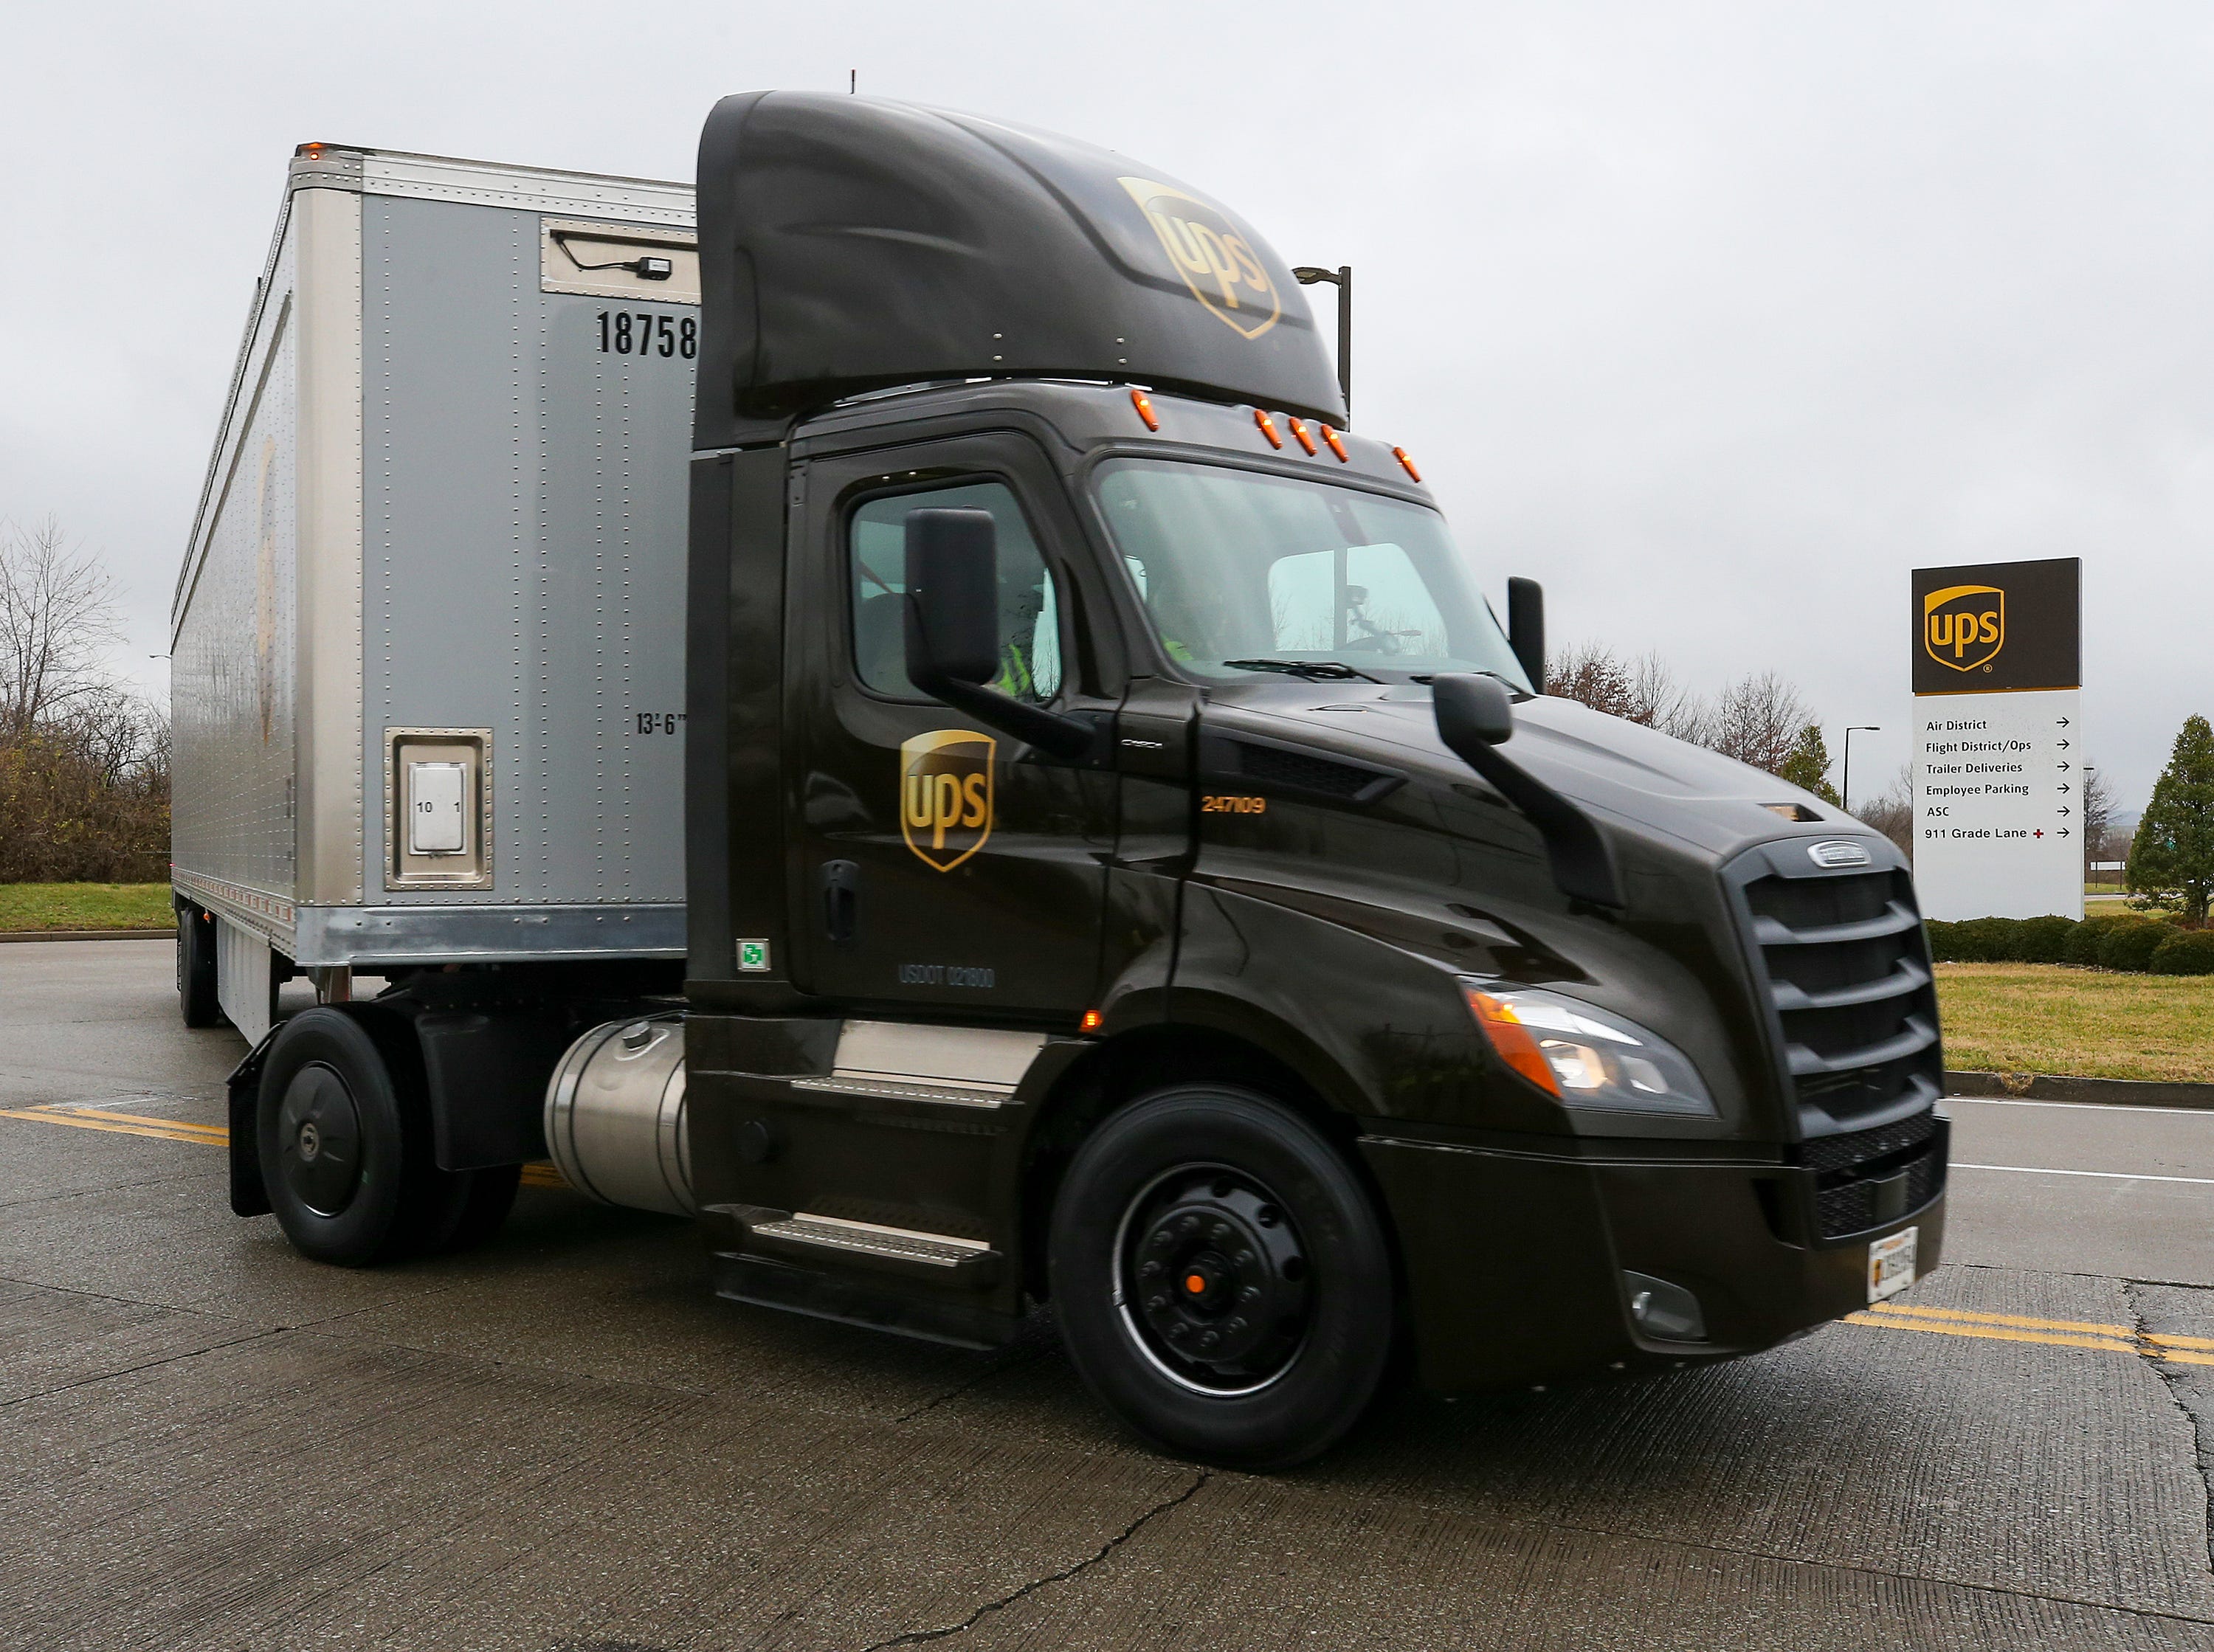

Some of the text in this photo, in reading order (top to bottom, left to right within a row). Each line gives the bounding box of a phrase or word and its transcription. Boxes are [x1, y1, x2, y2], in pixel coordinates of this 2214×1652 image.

[1150, 211, 1268, 308] ups
[597, 311, 697, 359] 18758
[1931, 611, 1999, 658] ups
[1926, 719, 1987, 731] Air District
[1925, 740, 2032, 755] Flight District/Ops
[1926, 762, 2023, 774] Trailer Deliveries
[1926, 784, 2030, 797] Employee Parking
[416, 801, 461, 813] 10 1
[906, 773, 987, 850] ups
[1201, 795, 1266, 814] 247109
[1926, 806, 1950, 817] ASC
[1925, 828, 2027, 839] 911 Grade Lane
